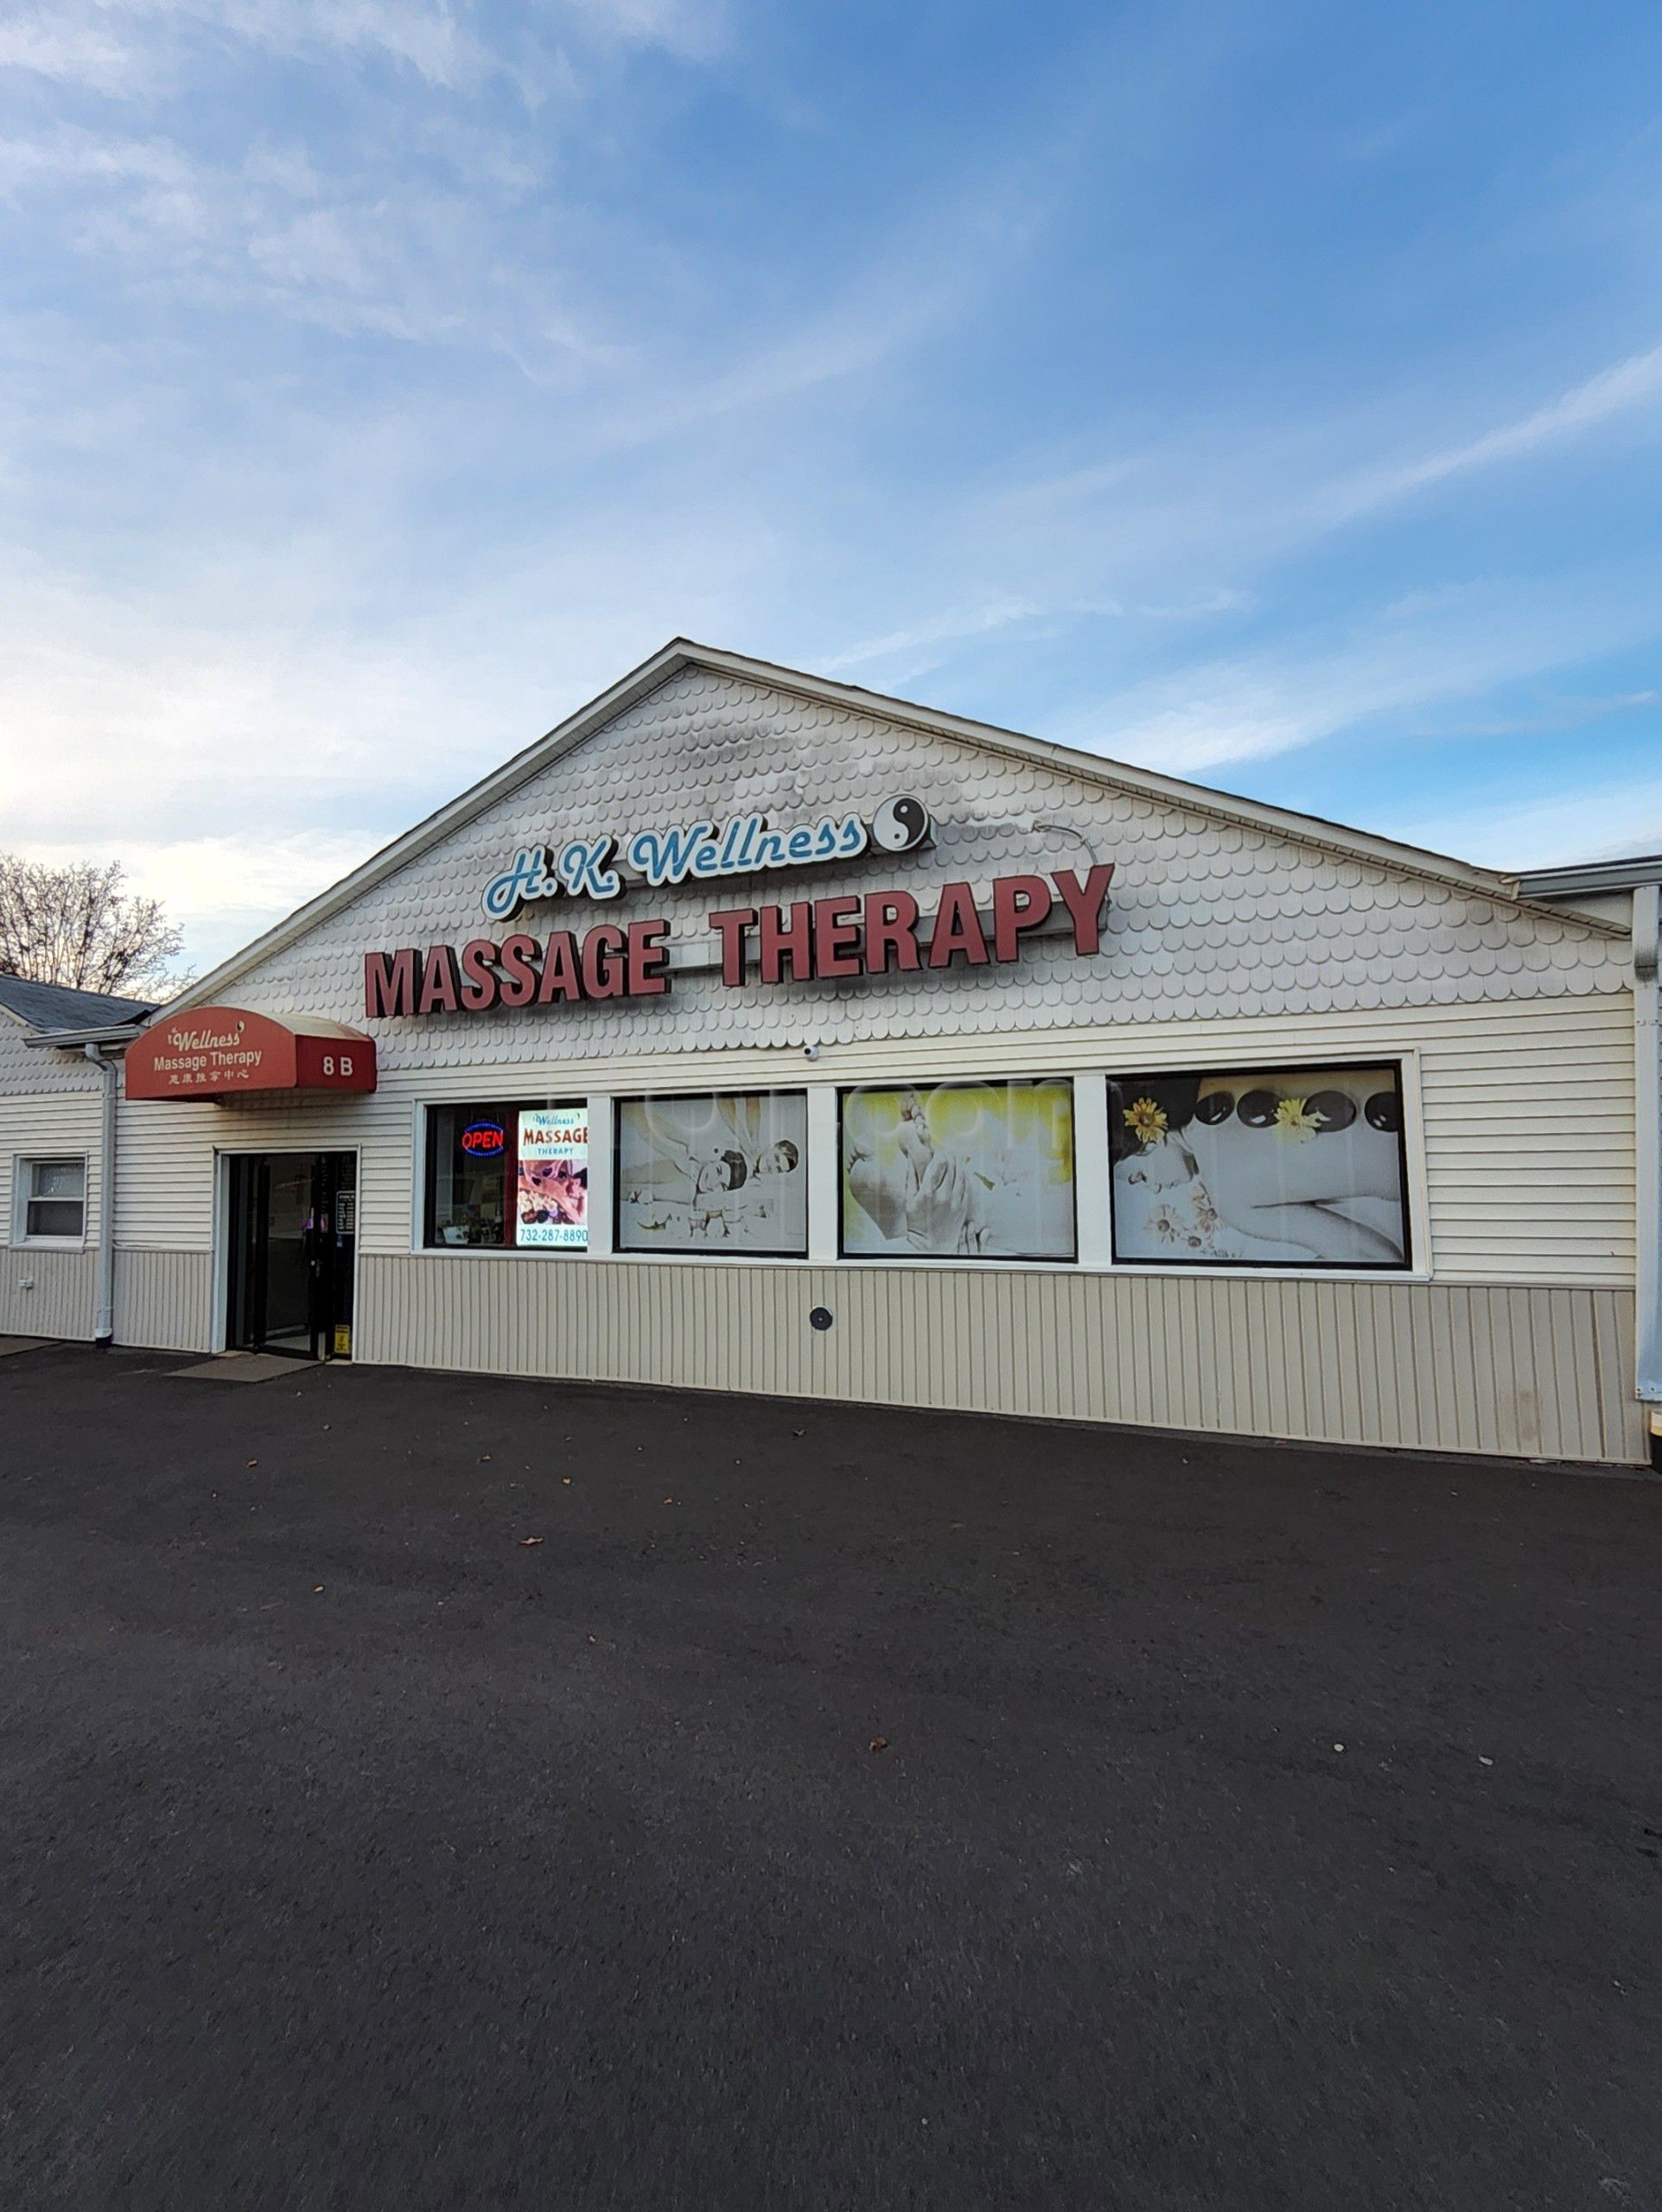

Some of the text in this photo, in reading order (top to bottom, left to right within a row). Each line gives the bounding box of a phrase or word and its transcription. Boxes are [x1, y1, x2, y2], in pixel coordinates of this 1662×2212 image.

[631, 814, 864, 881] Wellness
[365, 864, 1115, 1019] MASSAGE THERAPY
[173, 1029, 241, 1052] Wellness
[154, 1051, 262, 1071] Massage Therapy
[536, 1115, 575, 1125] Wellness
[462, 1130, 503, 1148] OPEN
[538, 1147, 574, 1156] THERAPY
[520, 1228, 589, 1243] 732-287-8890
